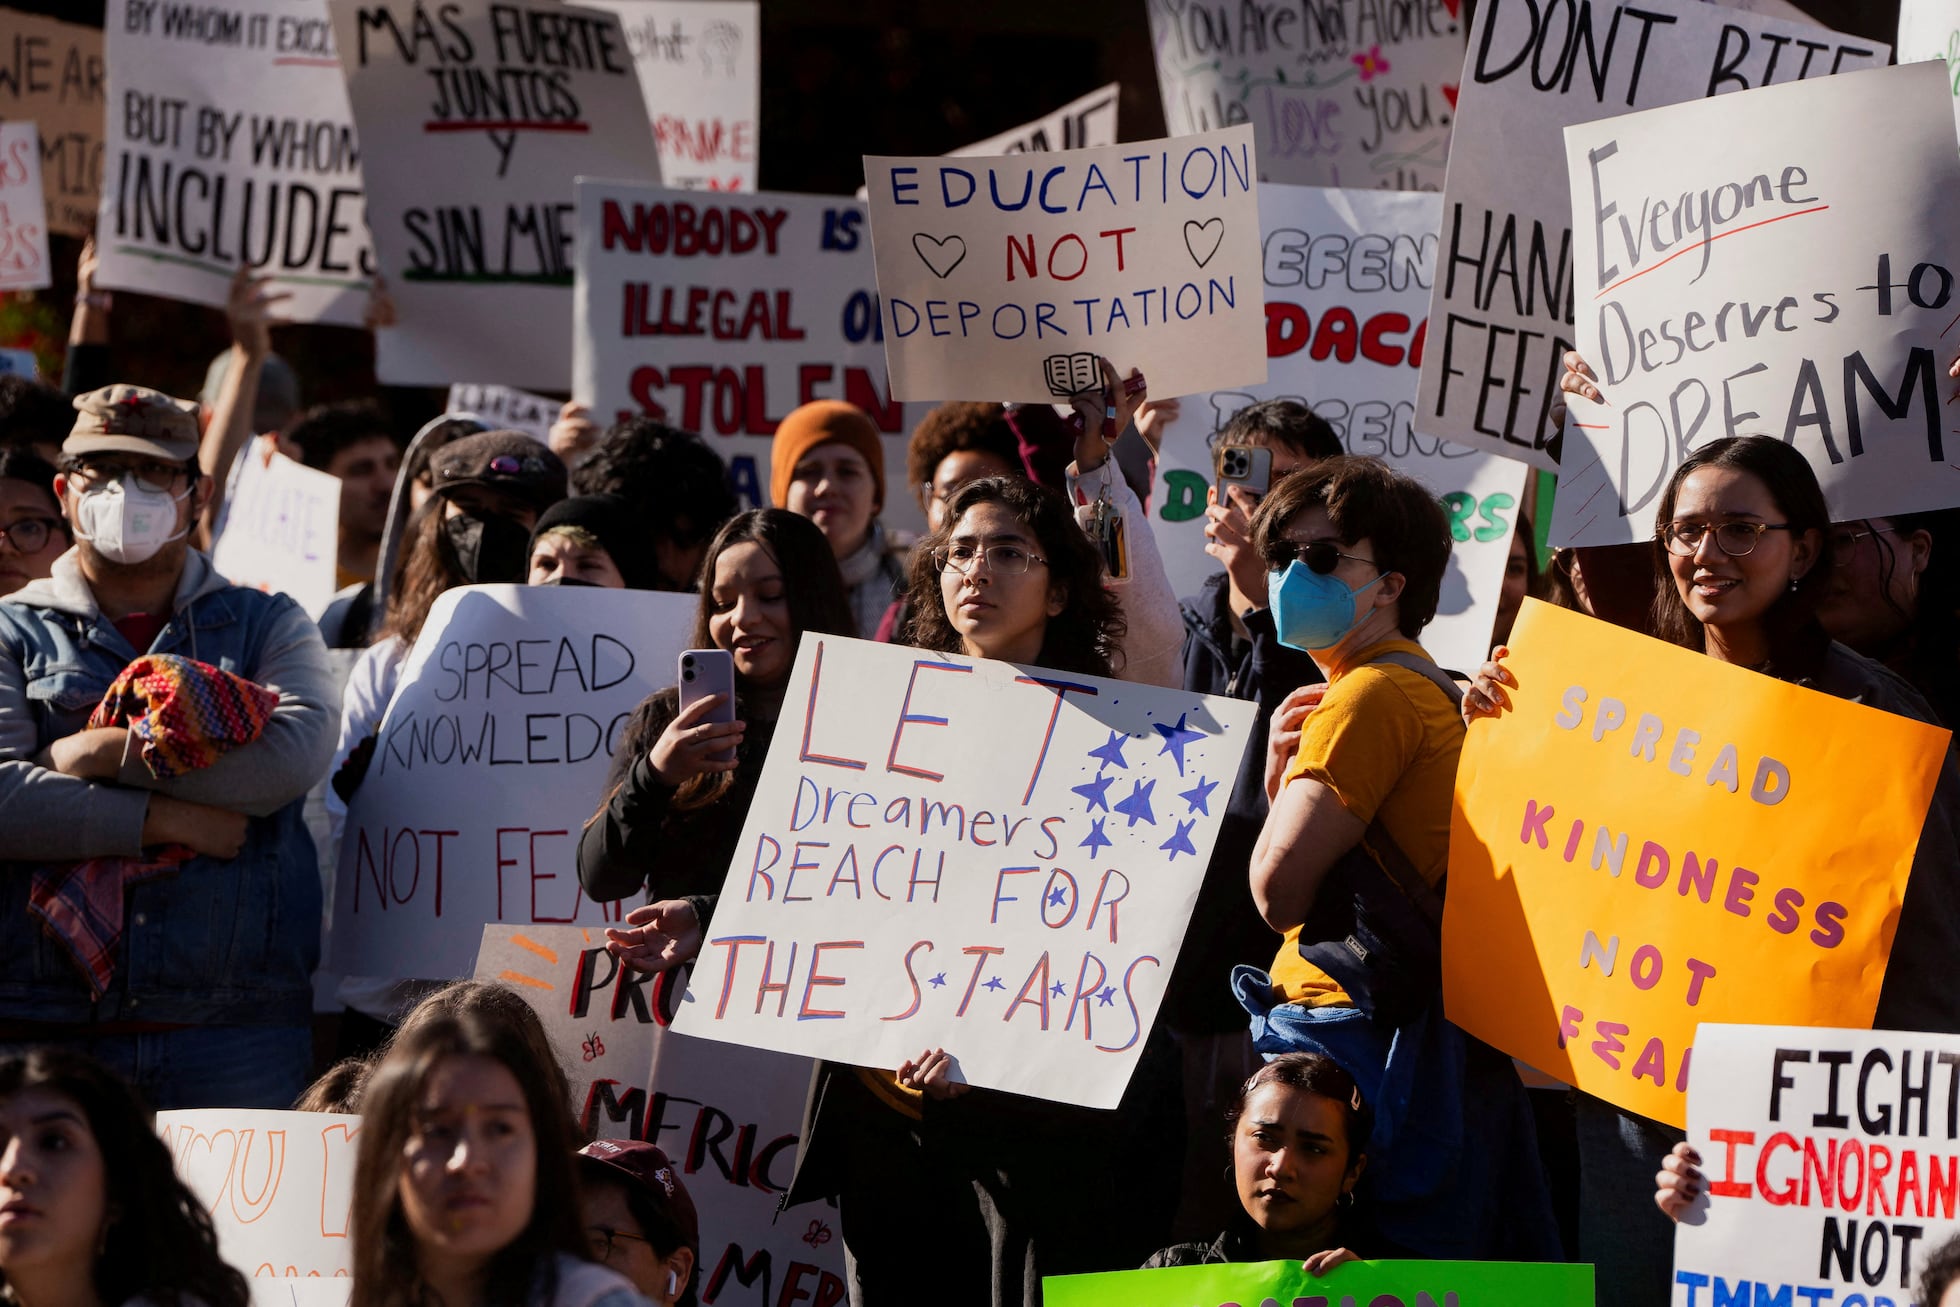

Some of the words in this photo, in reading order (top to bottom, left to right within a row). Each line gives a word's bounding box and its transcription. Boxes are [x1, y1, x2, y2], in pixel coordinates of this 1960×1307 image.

[162, 4, 243, 45] WHOM
[249, 14, 269, 48] IT
[488, 6, 627, 75] FUERTE
[1238, 0, 1298, 54] Are
[1475, 0, 1678, 106] DONT
[124, 88, 187, 150] BUT
[199, 105, 242, 161] BY
[427, 67, 581, 121] JUNTOS
[890, 143, 1249, 214] EDUCATION
[1588, 139, 1820, 291] Everyone
[403, 206, 488, 273] SIN
[601, 199, 788, 257] NOBODY
[820, 208, 864, 252] IS
[1006, 226, 1137, 281] NOT
[1444, 203, 1575, 326] HAN
[622, 282, 806, 341] ILLEGAL
[890, 275, 1236, 339] DEPORTATION
[1599, 292, 1841, 387] Deserves
[1855, 252, 1956, 316] to
[1618, 345, 1945, 517] DREAM
[434, 633, 635, 702] SPREAD
[800, 641, 1098, 806] LET
[1555, 685, 1791, 805] SPREAD
[790, 775, 1066, 860] Dreamers
[353, 827, 460, 919] NOT
[745, 832, 945, 903] REACH
[990, 865, 1130, 944] FOR
[1519, 799, 1849, 949] KINDNESS
[711, 935, 866, 1020] THE
[1579, 930, 1717, 1007] NOT
[1768, 1047, 1960, 1140] FIGHT
[1709, 1128, 1960, 1220] IGNORAN
[1818, 1215, 1924, 1289] NOT
